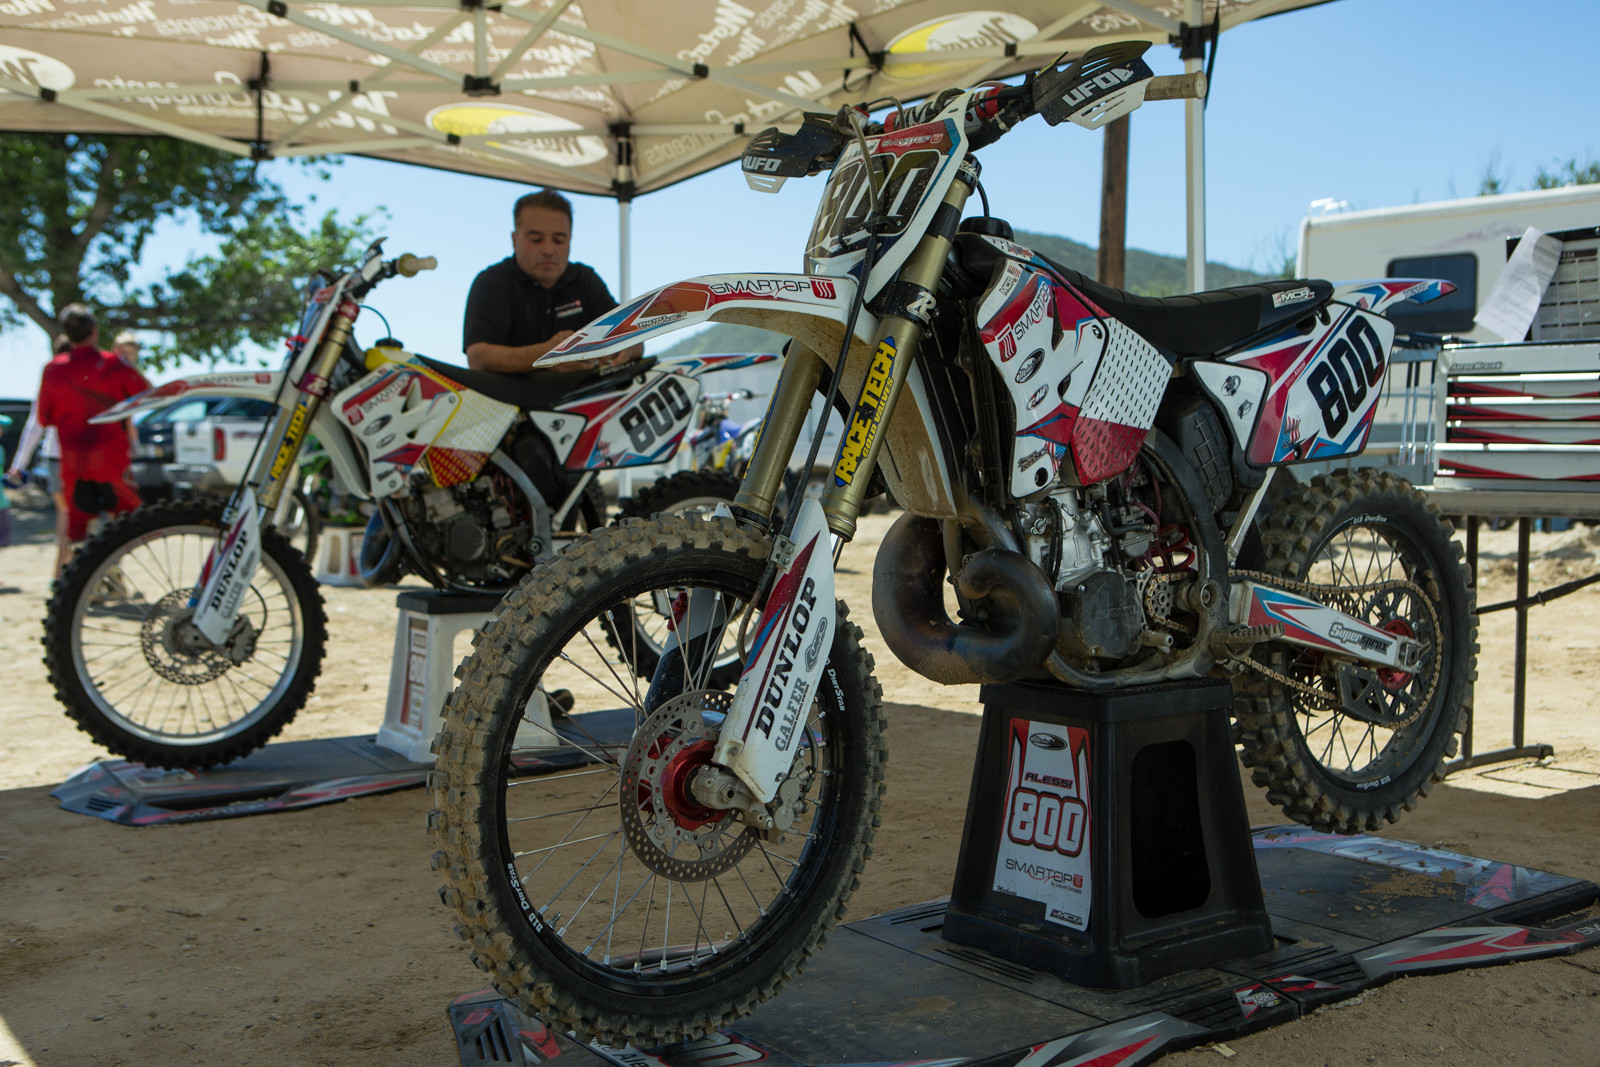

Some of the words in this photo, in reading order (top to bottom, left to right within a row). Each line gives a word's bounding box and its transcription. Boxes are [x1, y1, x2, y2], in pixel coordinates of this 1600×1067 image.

[1061, 71, 1117, 105] UFO
[747, 157, 782, 172] UFO
[709, 278, 812, 298] SMARTOP
[1280, 288, 1310, 302] MCR
[835, 411, 872, 486] RACE
[859, 339, 897, 408] TECH
[1307, 315, 1386, 439] 800
[619, 377, 692, 453] 800
[862, 424, 879, 460] GOLD
[875, 376, 894, 426] VALVES
[211, 531, 249, 612] DUNLOP
[755, 577, 817, 740] DUNLOP
[775, 677, 808, 752] GALFER
[1024, 771, 1074, 790] ALESSI
[1007, 786, 1088, 858] 800
[1005, 858, 1073, 884] SMARTOP
[528, 912, 544, 933] DID
